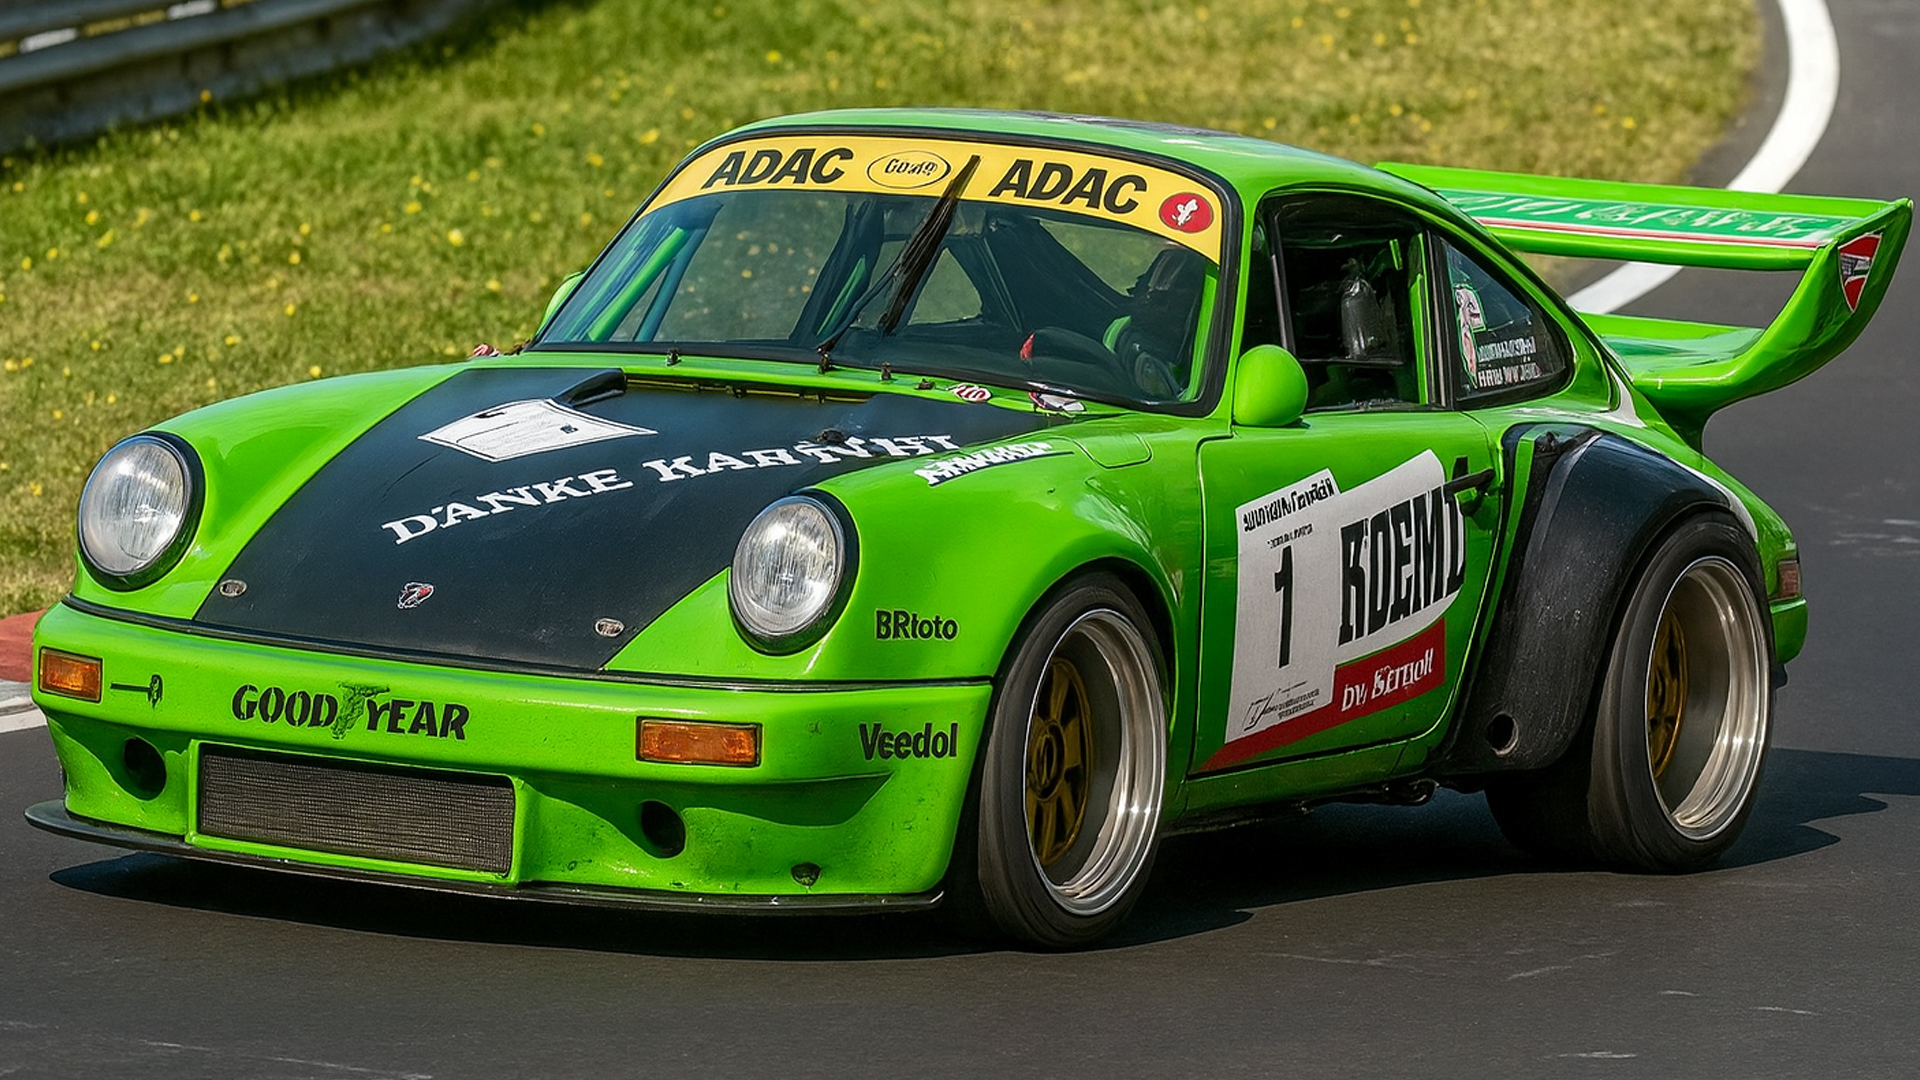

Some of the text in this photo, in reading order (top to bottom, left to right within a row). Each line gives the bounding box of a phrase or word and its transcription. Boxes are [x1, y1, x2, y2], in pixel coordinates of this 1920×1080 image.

[701, 148, 854, 190] ADAC
[988, 159, 1147, 214] ADAC
[381, 469, 634, 545] DANKE
[876, 609, 959, 640] BRtoto
[1274, 545, 1294, 669] 1
[858, 722, 958, 760] Veedol
